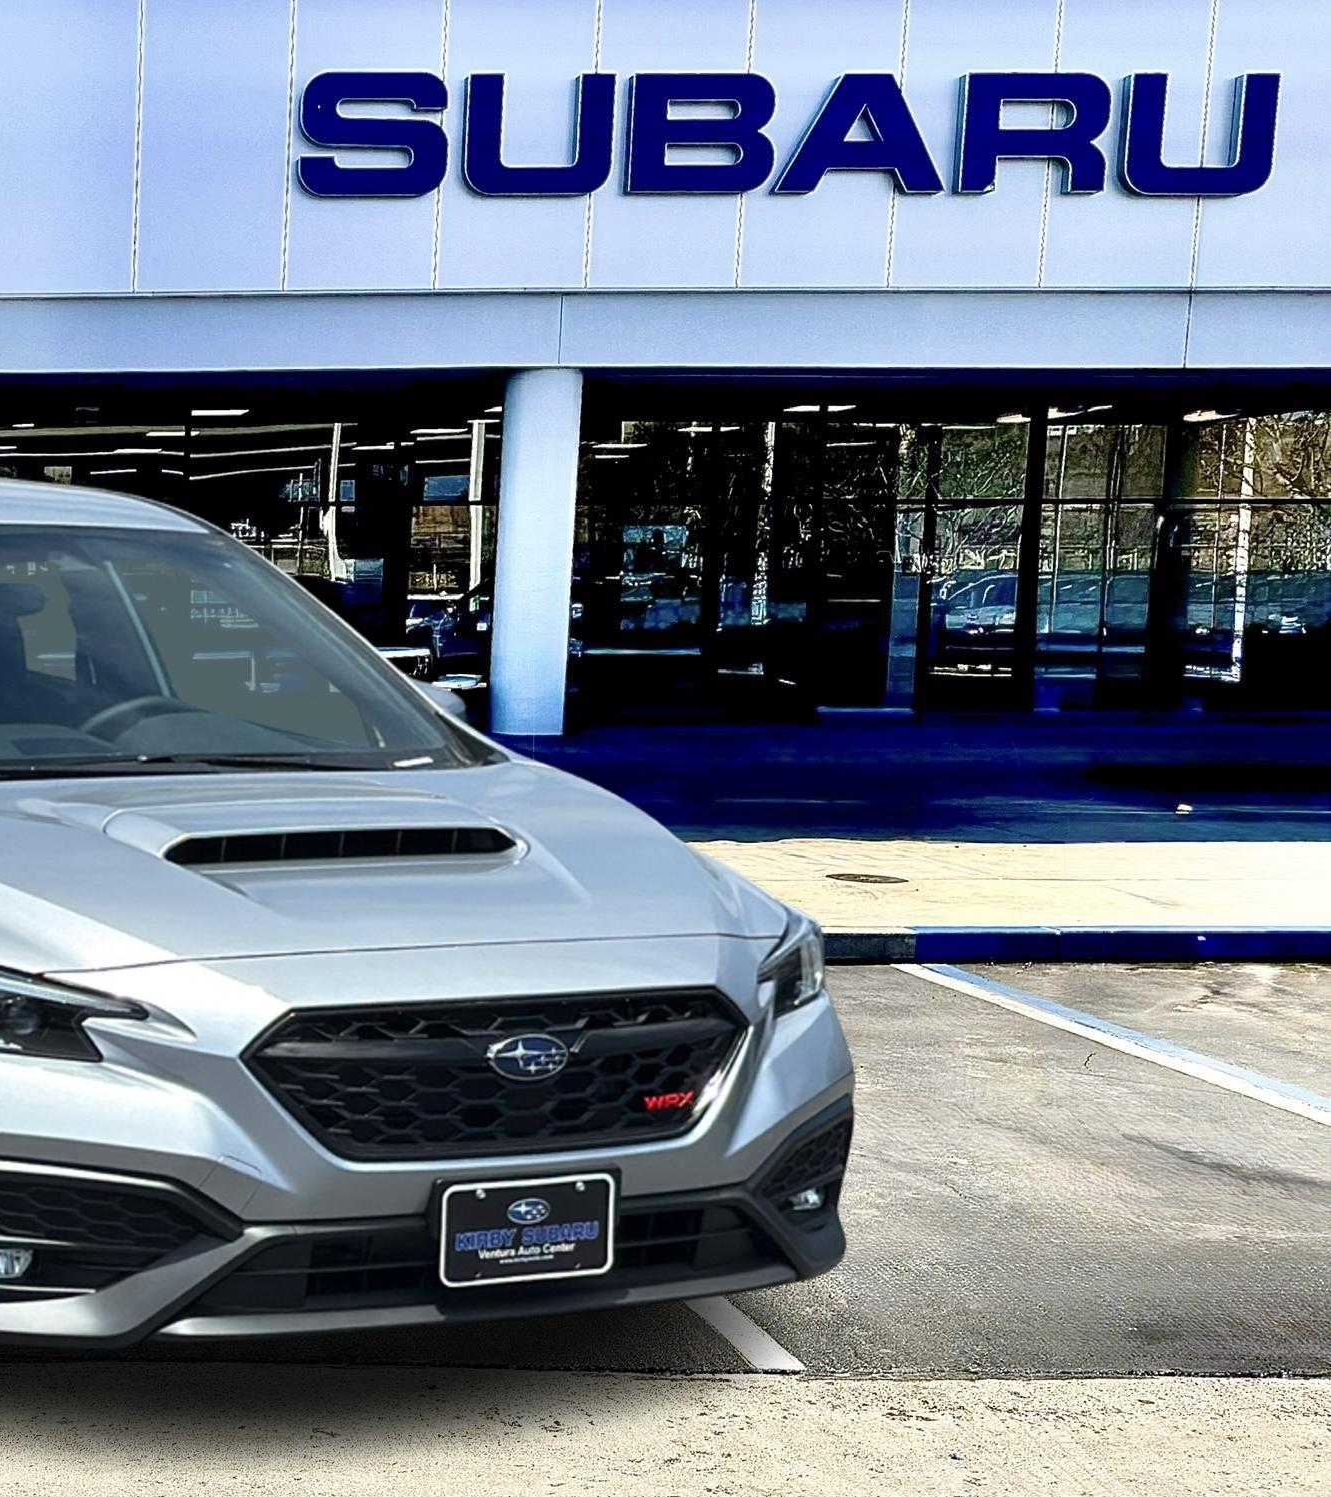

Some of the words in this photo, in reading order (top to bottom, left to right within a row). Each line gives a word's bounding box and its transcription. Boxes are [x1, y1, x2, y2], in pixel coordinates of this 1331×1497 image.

[297, 71, 1282, 198] SUBARU
[644, 1090, 694, 1110] WRX
[454, 1228, 518, 1252] KIRBY
[521, 1220, 599, 1246] SUBARU
[478, 1247, 515, 1260] Ventura
[517, 1245, 541, 1256] Auto
[542, 1242, 576, 1254] Center
